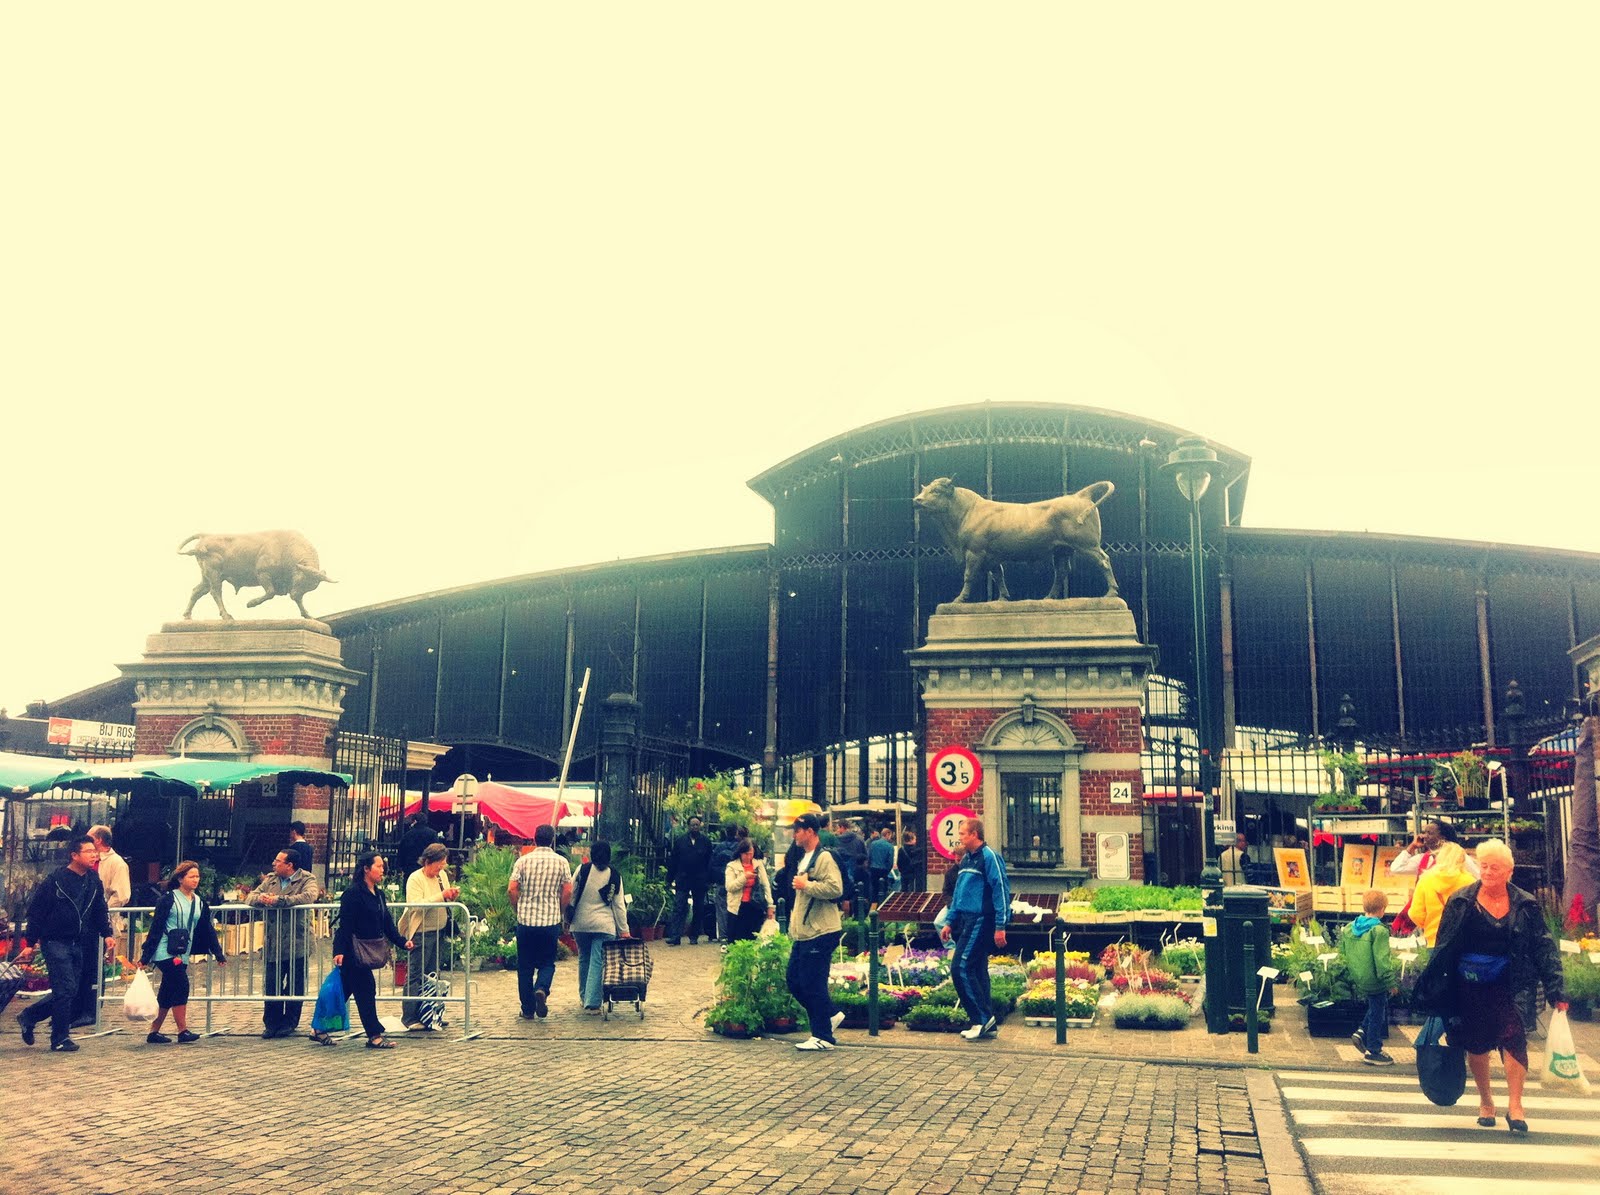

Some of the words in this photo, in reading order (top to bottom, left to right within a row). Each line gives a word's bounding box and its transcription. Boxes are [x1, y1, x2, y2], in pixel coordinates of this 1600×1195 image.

[99, 724, 113, 736] BIJ
[940, 761, 957, 786] 3
[961, 772, 969, 784] 5
[263, 783, 276, 793] 24
[1113, 787, 1129, 798] 24
